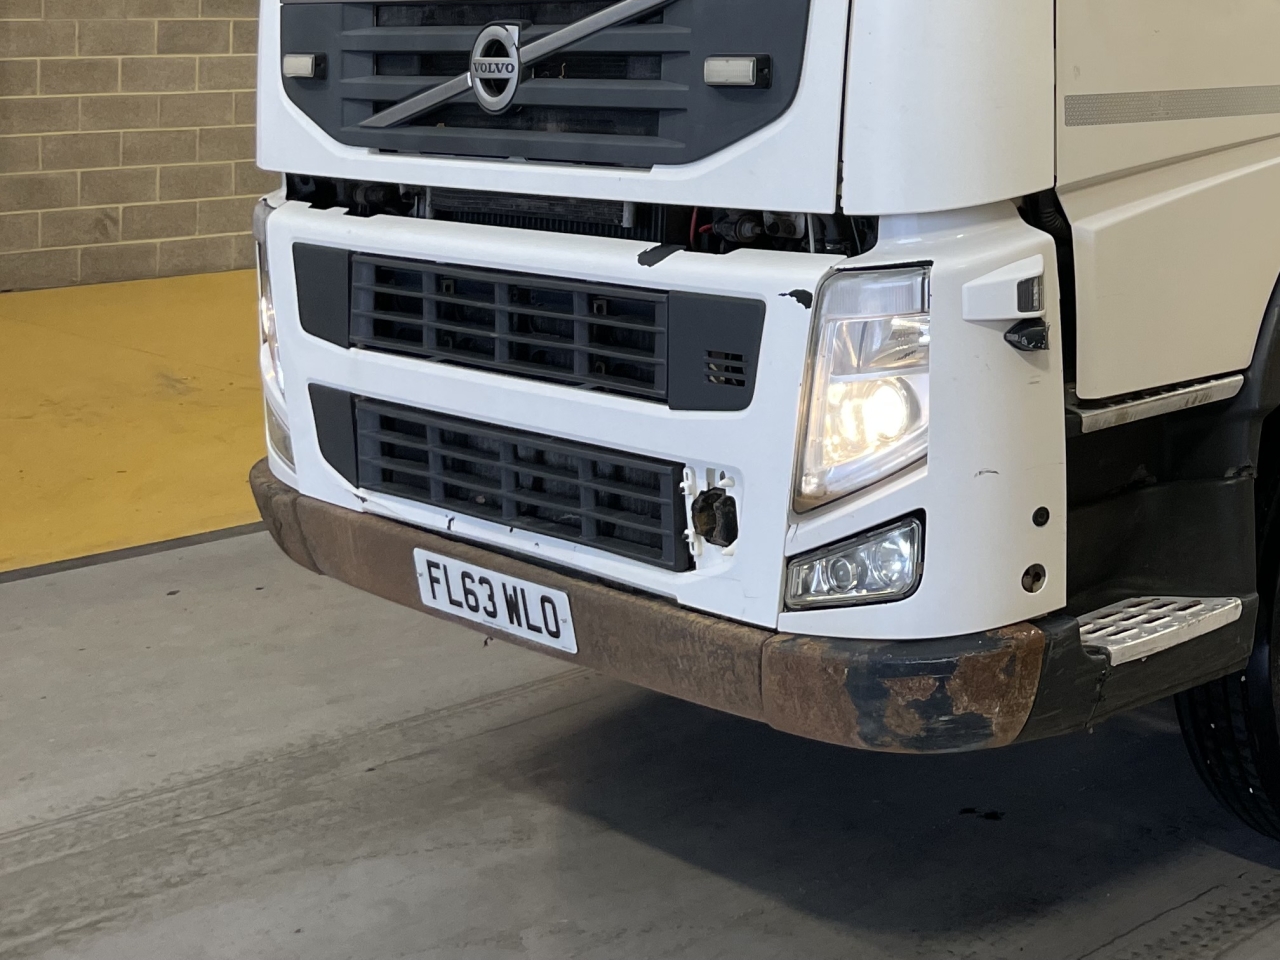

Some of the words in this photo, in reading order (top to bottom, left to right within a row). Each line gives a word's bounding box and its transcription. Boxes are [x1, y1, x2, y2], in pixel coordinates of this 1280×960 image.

[473, 62, 516, 74] VOLVO
[426, 558, 498, 620] FL63
[501, 582, 562, 640] WLO
